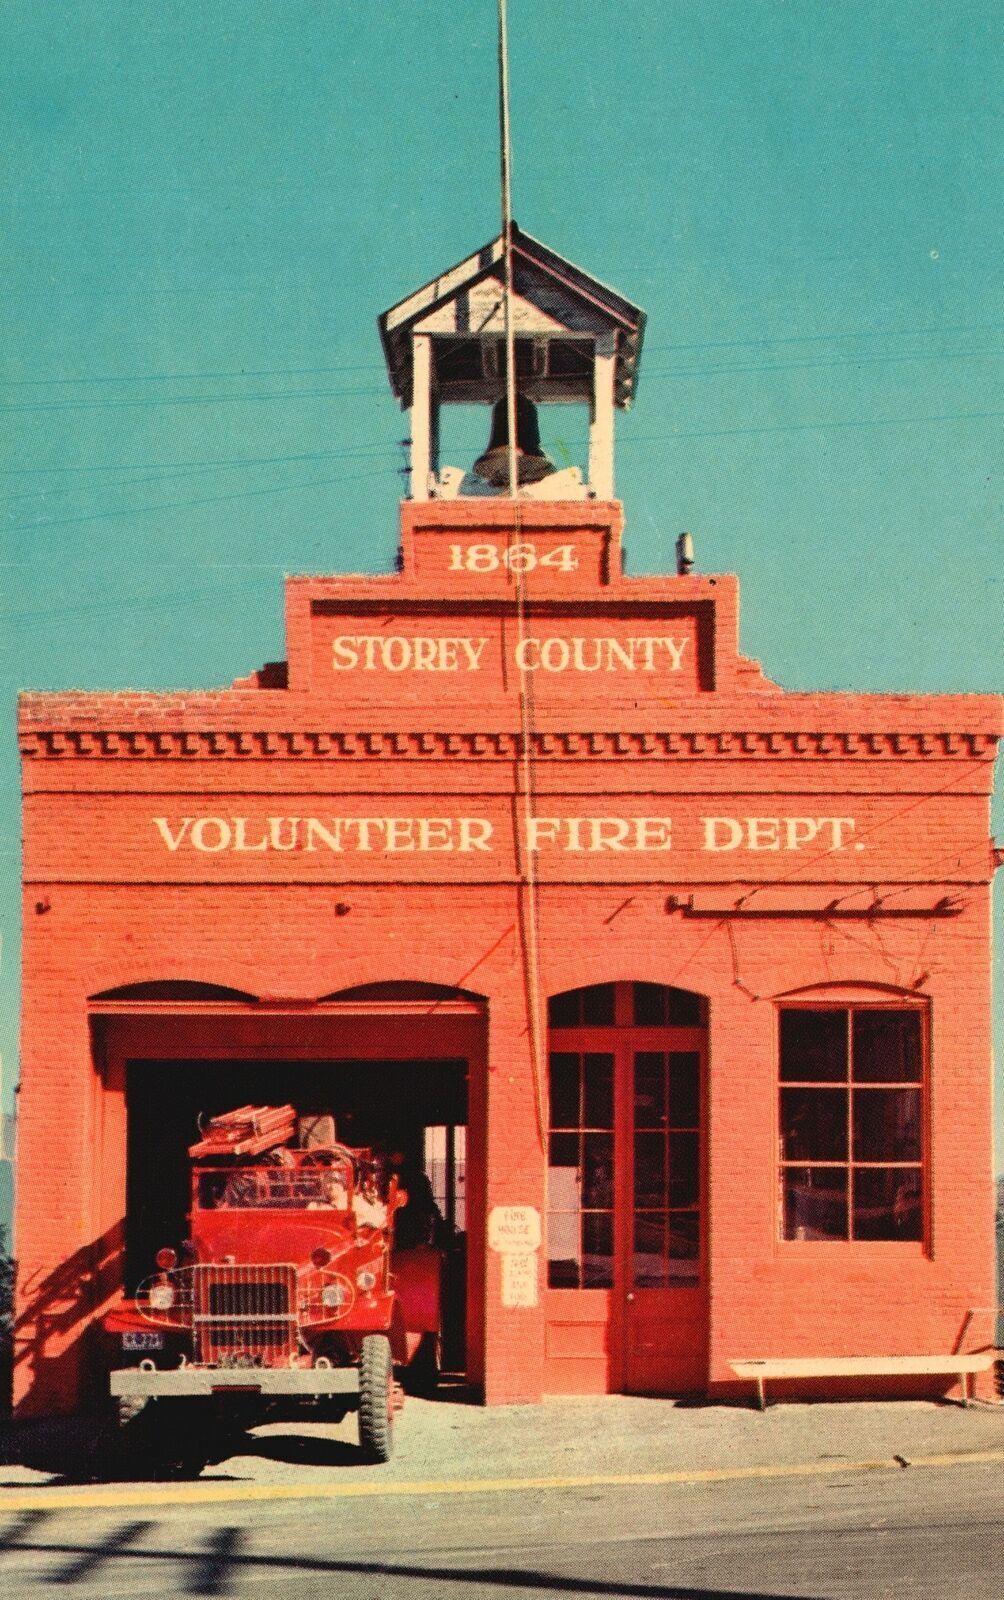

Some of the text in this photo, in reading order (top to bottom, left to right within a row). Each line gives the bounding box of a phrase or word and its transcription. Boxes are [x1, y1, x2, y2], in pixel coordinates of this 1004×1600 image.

[448, 542, 579, 573] 1864
[332, 635, 690, 672] STOREY COUNTY
[152, 816, 866, 852] VOLUNTEER FIRE DEPT.
